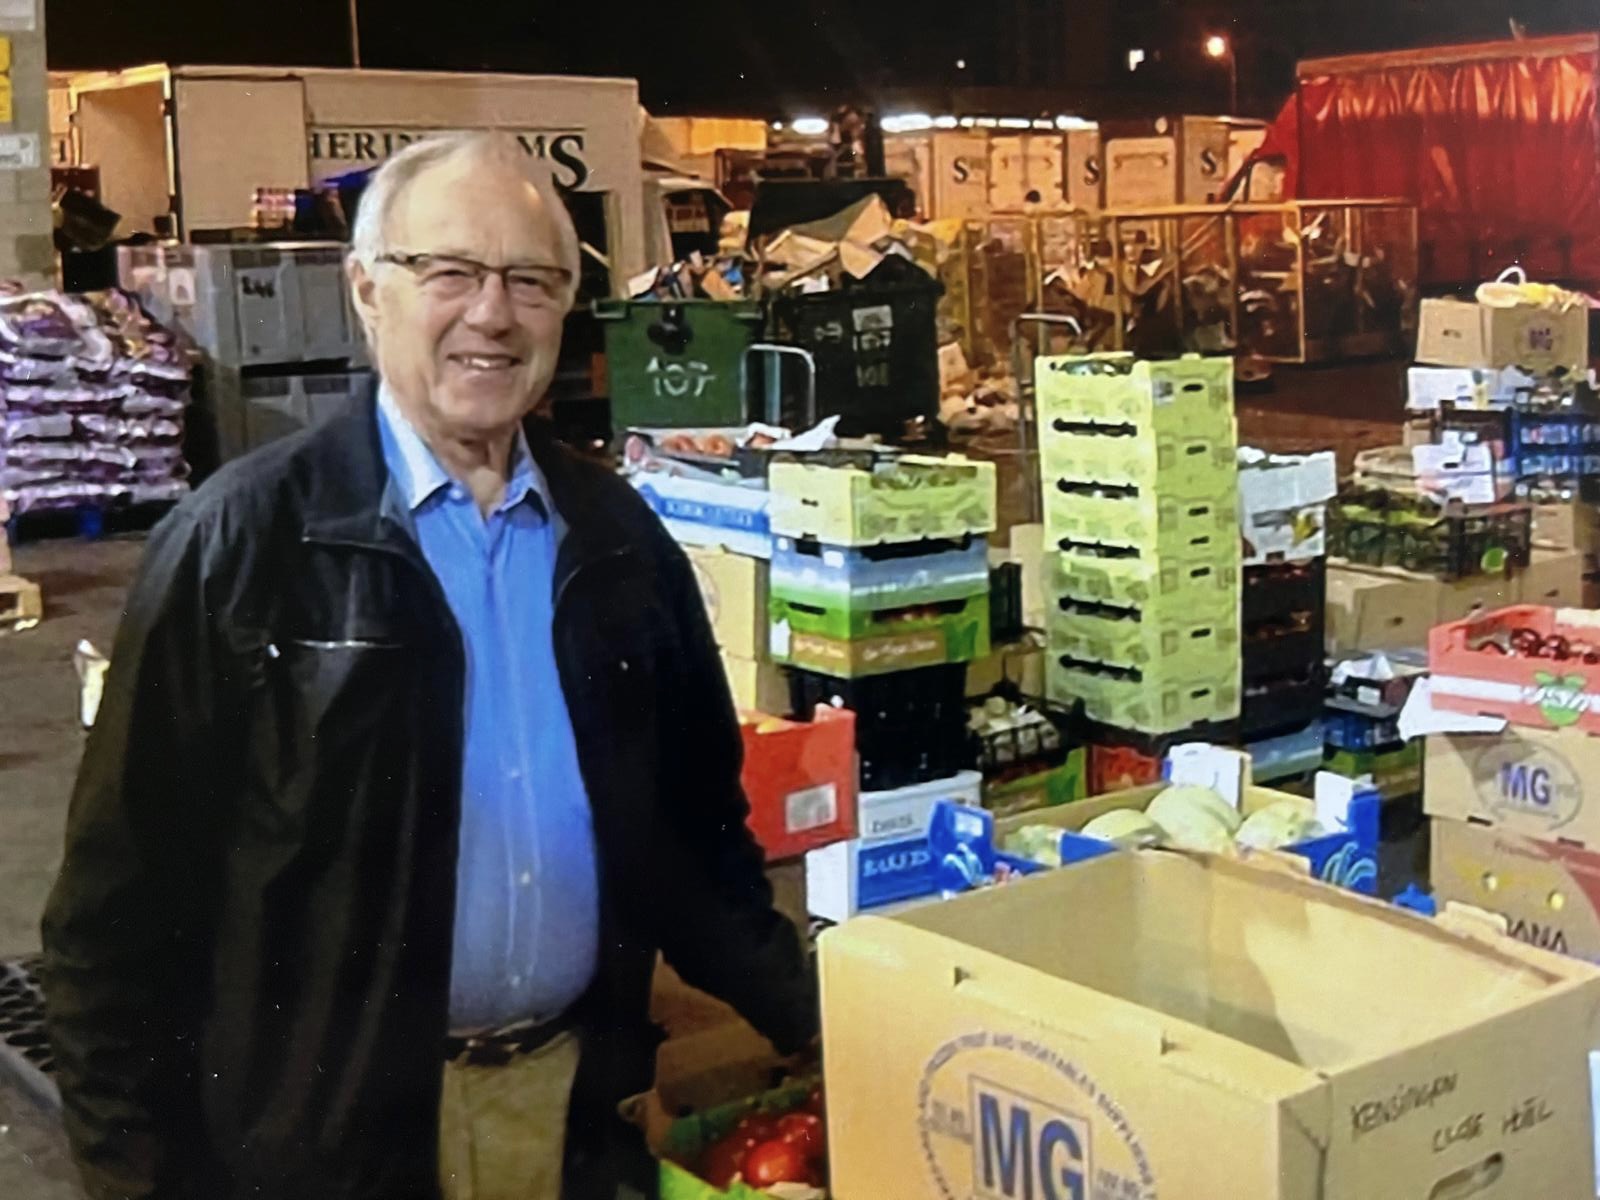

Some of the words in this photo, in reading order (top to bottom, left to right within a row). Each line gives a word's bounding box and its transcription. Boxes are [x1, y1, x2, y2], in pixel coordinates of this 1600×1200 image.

[645, 356, 717, 397] 107
[1501, 761, 1551, 806] MG
[979, 1092, 1084, 1199] MG
